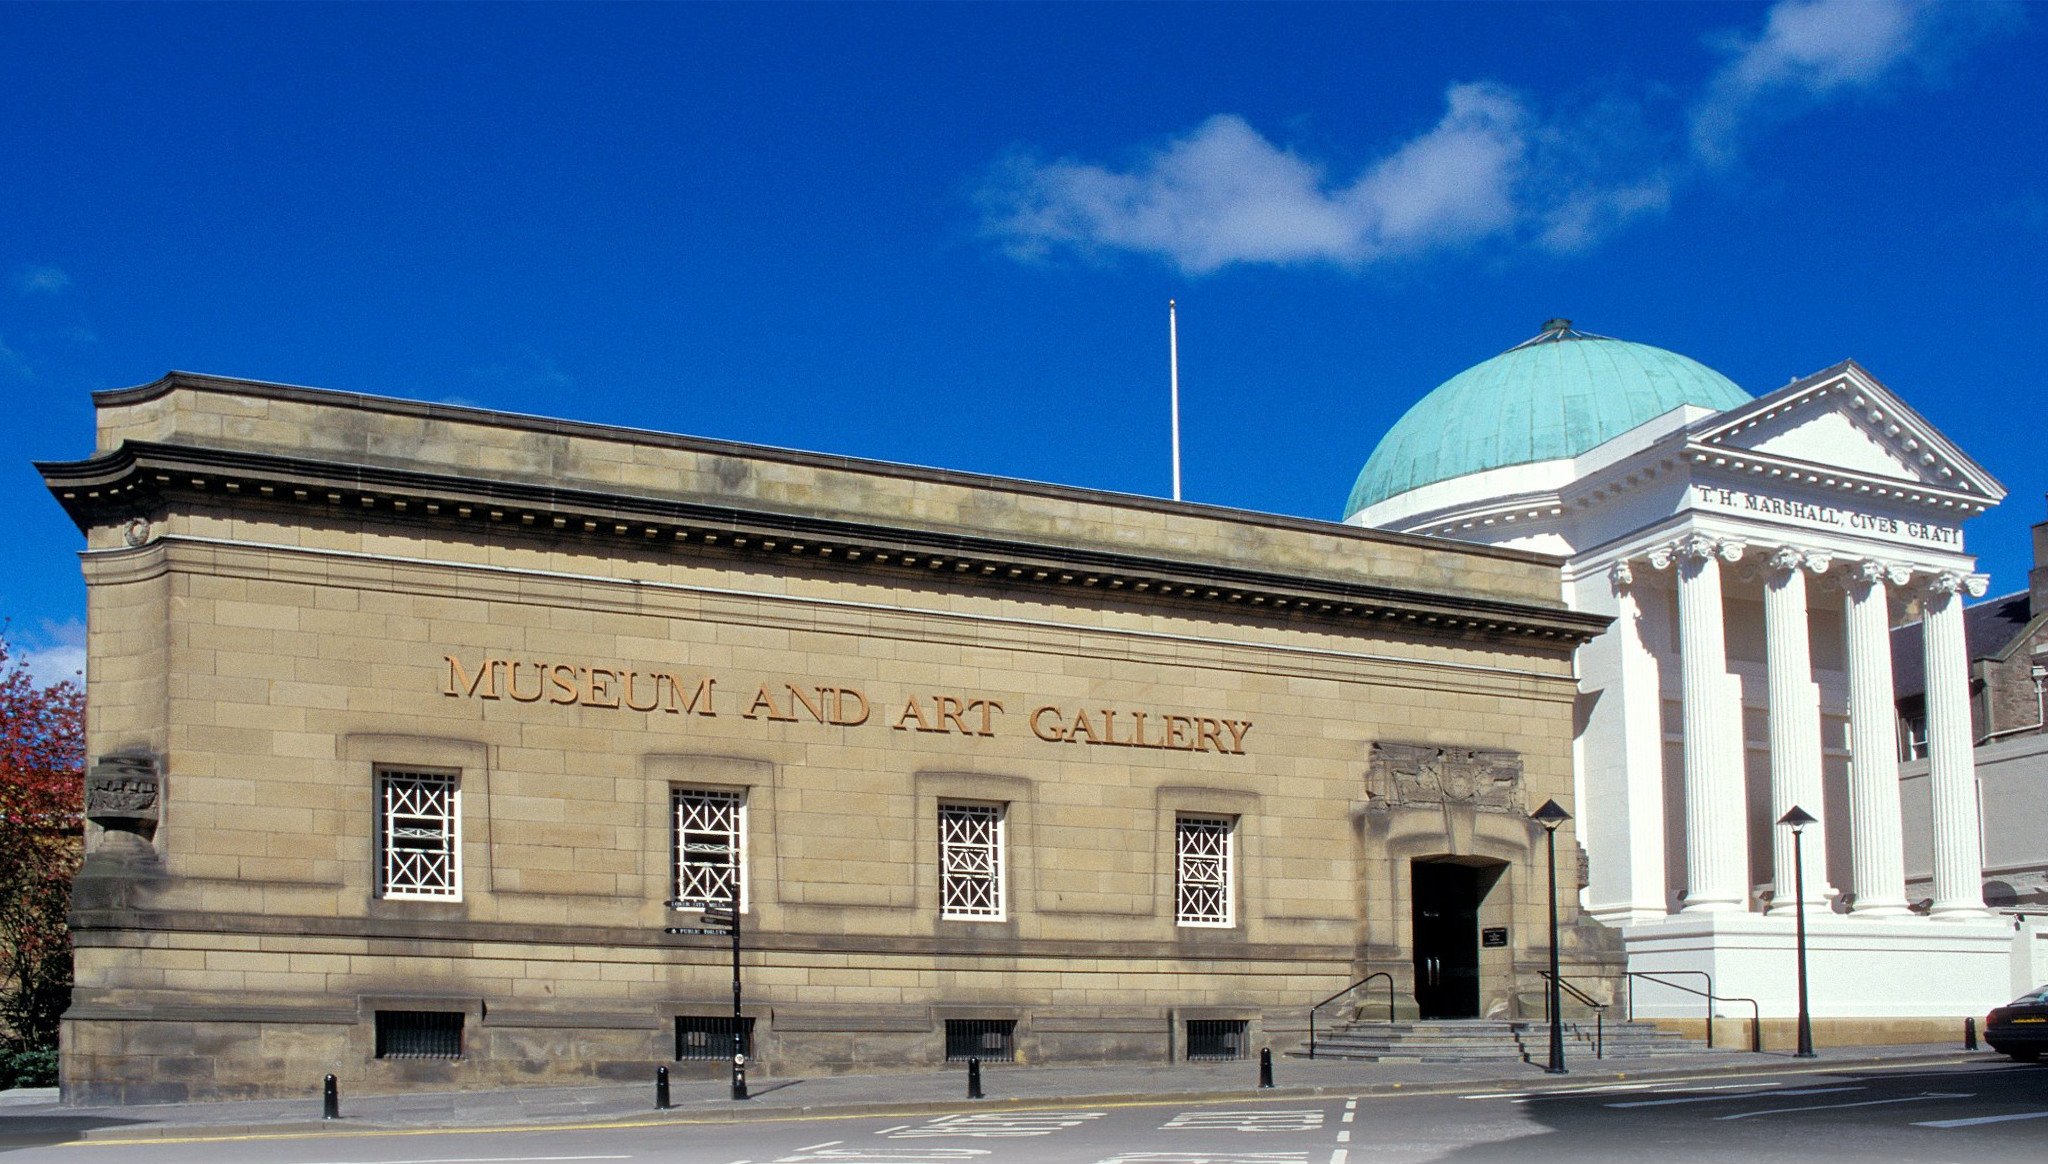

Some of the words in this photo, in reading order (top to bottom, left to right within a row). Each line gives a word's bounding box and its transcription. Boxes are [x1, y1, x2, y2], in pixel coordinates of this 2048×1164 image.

[1699, 486, 1712, 503] T.
[1718, 490, 1737, 507] H.
[1744, 494, 1845, 528] MARSHALL,
[1850, 514, 1898, 534] CIVES
[1907, 522, 1960, 545] GRATI
[443, 655, 717, 718] MUSEUM
[742, 681, 871, 727] AND
[893, 694, 1005, 738] ART
[1029, 706, 1253, 756] GALLERY
[888, 1112, 1108, 1139] CLEAR
[1157, 1109, 1324, 1132] KEEP
